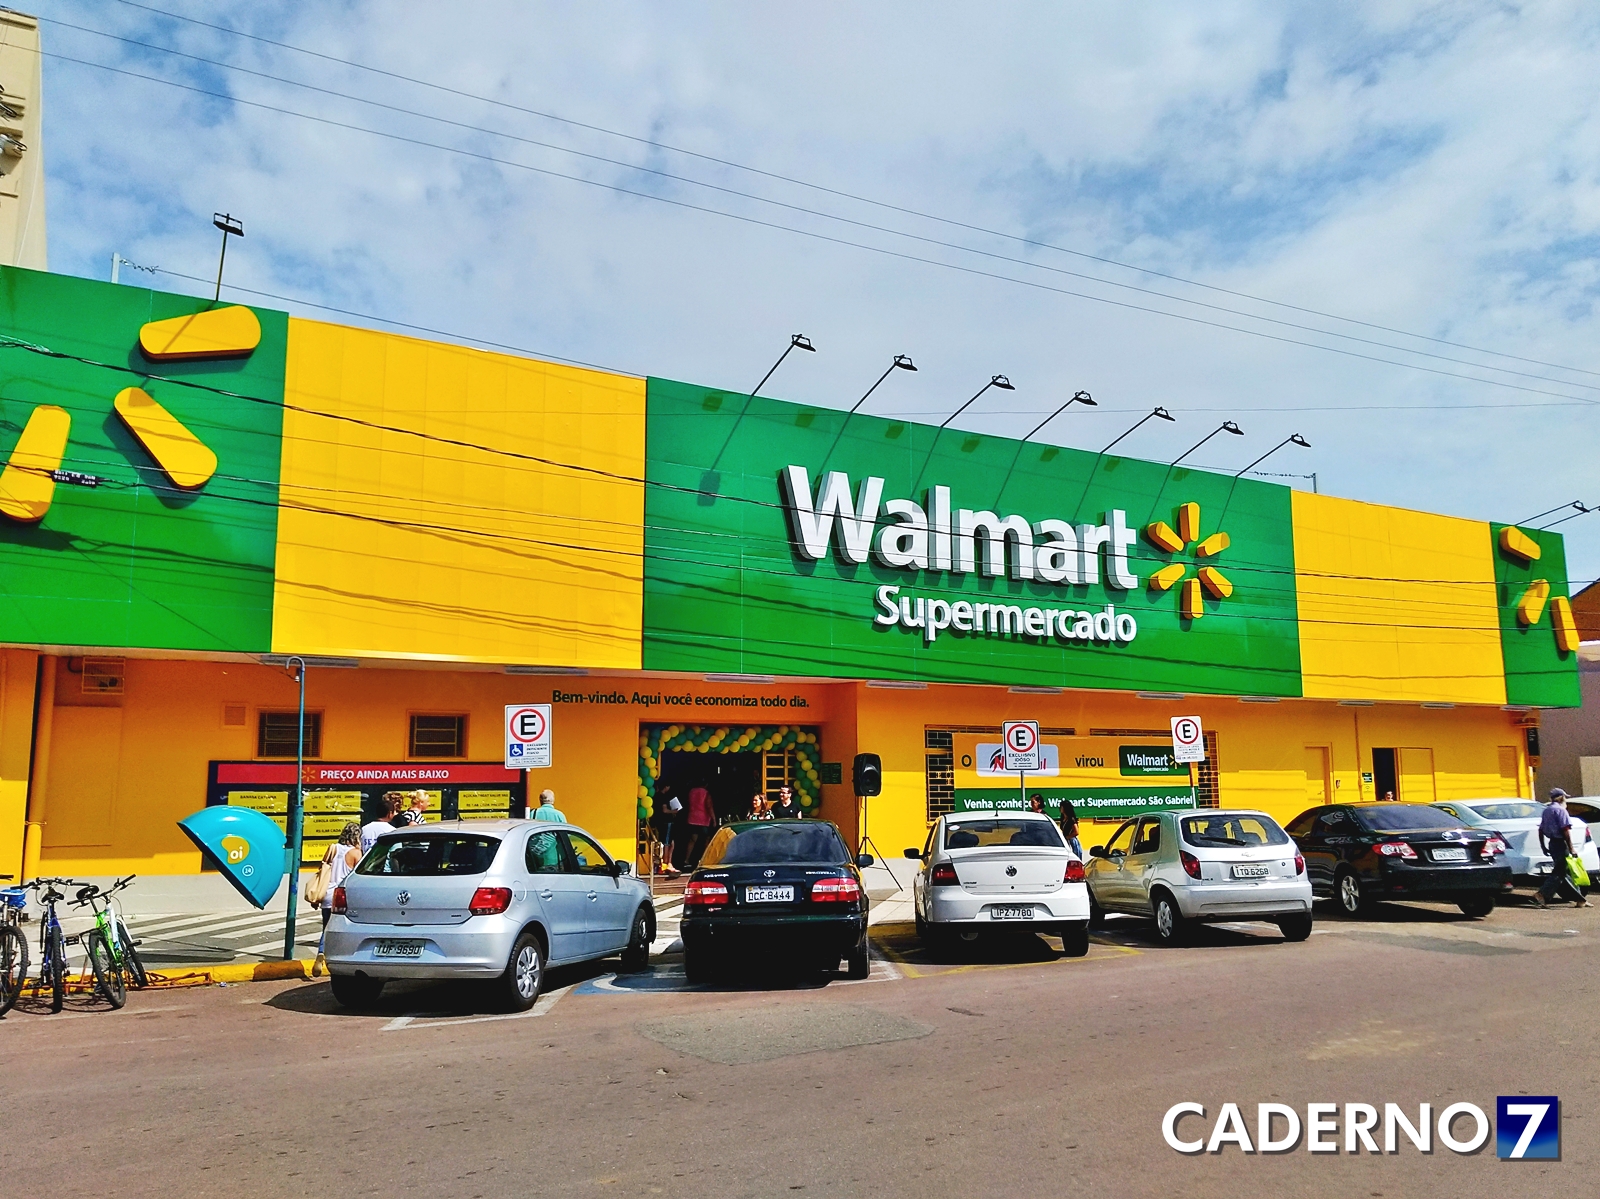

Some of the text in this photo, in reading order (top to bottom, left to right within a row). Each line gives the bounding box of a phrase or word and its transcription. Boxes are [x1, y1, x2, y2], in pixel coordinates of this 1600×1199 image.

[783, 464, 1138, 590] Walmart
[874, 585, 1137, 642] Supermercado
[552, 690, 809, 707] Bem-vindo. Aqui você economiza todo dia.
[520, 714, 537, 736] E
[1182, 723, 1192, 739] E
[1015, 729, 1027, 747] E
[961, 754, 972, 768] O
[1075, 754, 1104, 767] virou
[1127, 754, 1169, 767] Walmart
[320, 769, 450, 781] PREÇO AINDA MAIS BAIXO
[963, 799, 993, 809] Venha
[1087, 797, 1146, 809] Supermercado
[1148, 796, 1163, 806] São
[1165, 796, 1192, 806] Gabriel
[230, 846, 243, 860] oi
